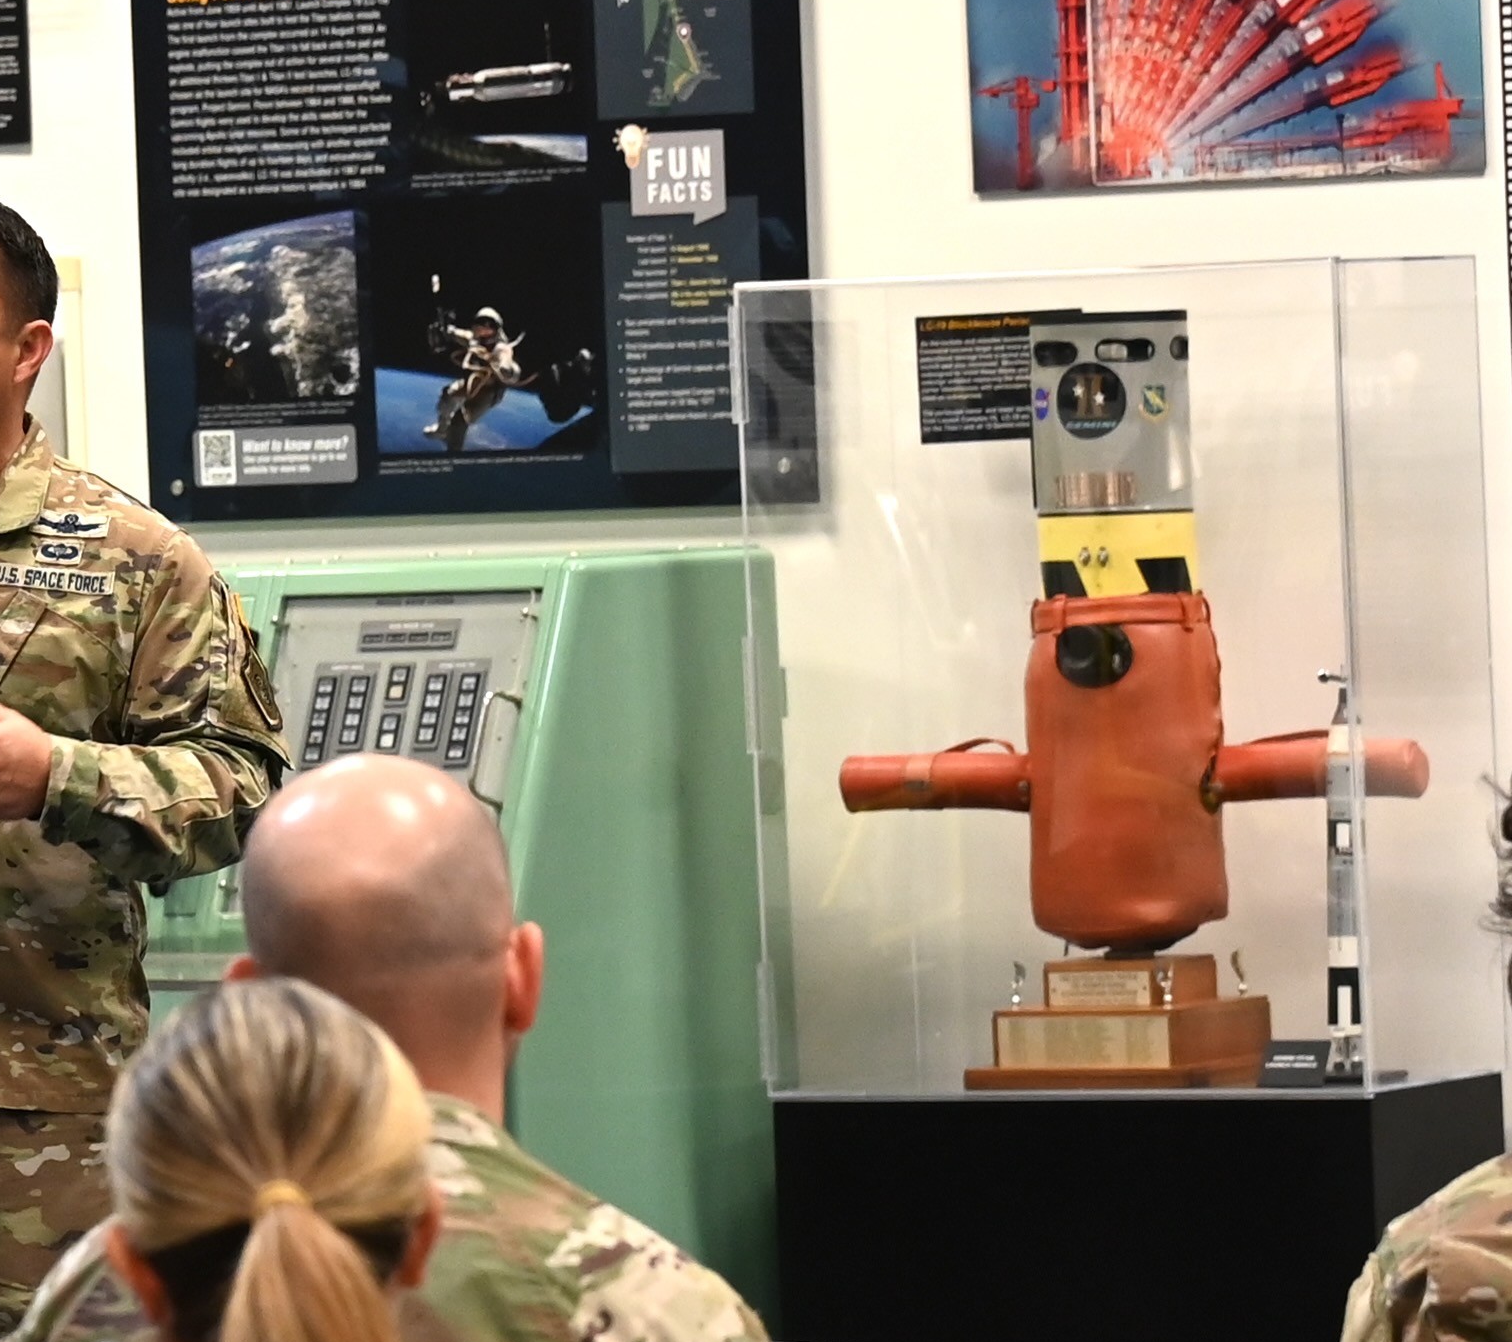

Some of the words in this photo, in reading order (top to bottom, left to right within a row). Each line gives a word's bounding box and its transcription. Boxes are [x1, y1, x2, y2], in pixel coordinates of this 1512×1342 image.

[647, 146, 712, 181] FUN
[647, 181, 713, 204] FACTS
[24, 571, 65, 590] SPACE
[67, 573, 109, 594] FORCE
